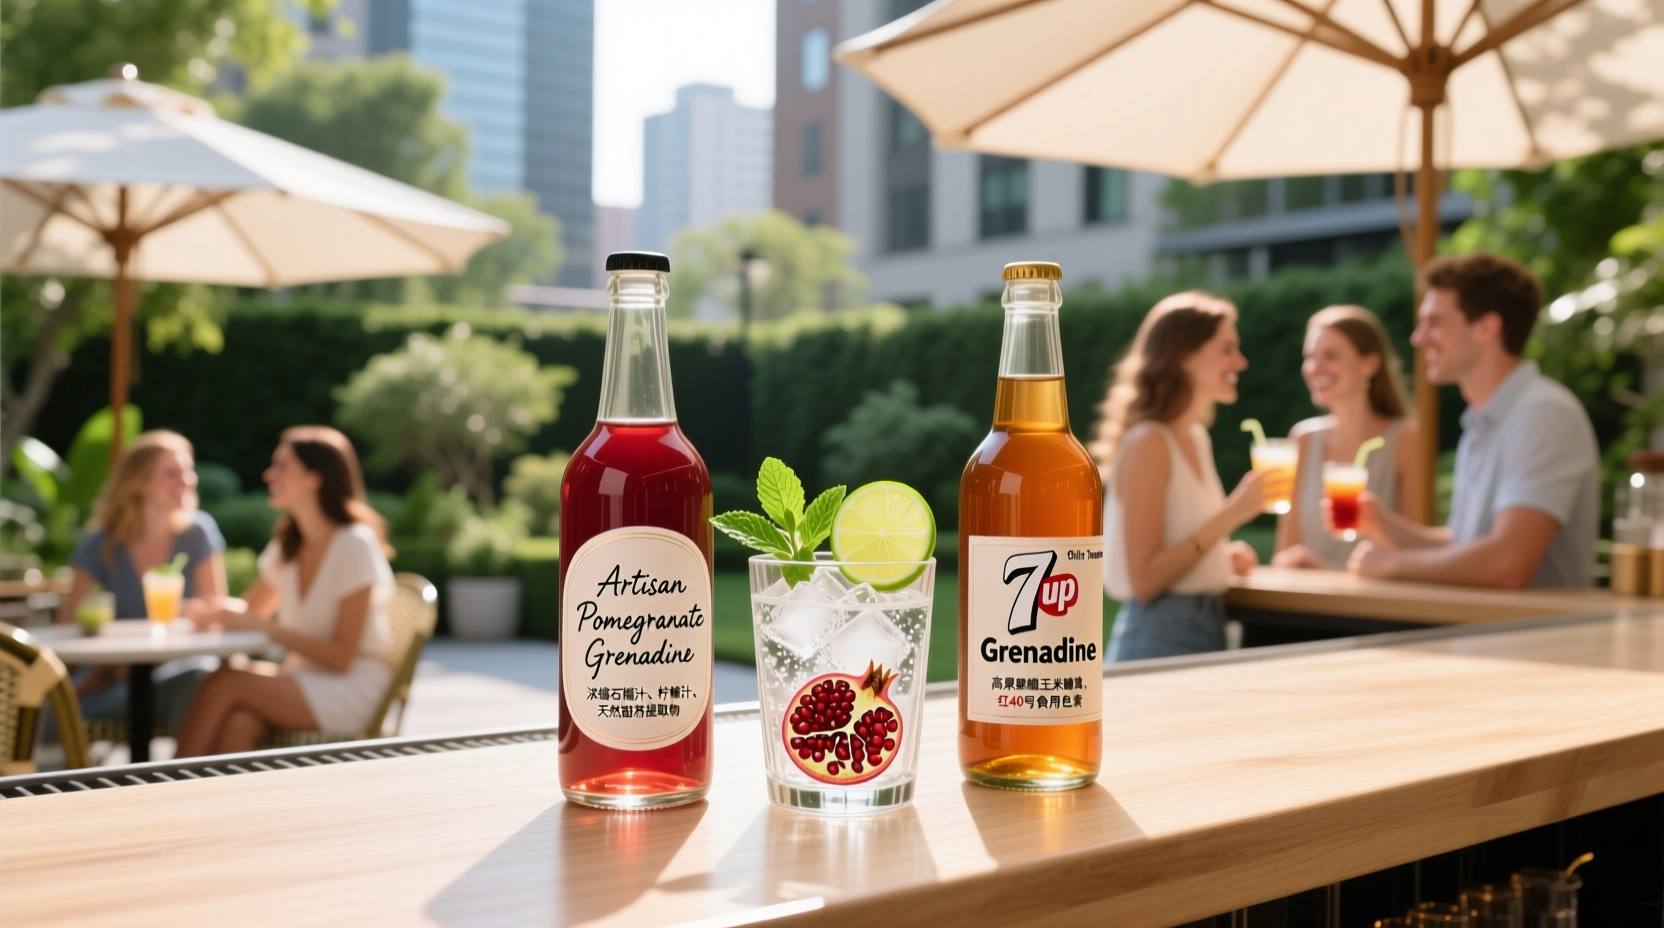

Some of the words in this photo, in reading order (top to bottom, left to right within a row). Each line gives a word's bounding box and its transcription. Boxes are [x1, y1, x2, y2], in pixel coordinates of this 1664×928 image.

[596, 564, 687, 597] Artisan
[585, 637, 695, 680] Grenadine
[980, 637, 1097, 664] Grenadine
